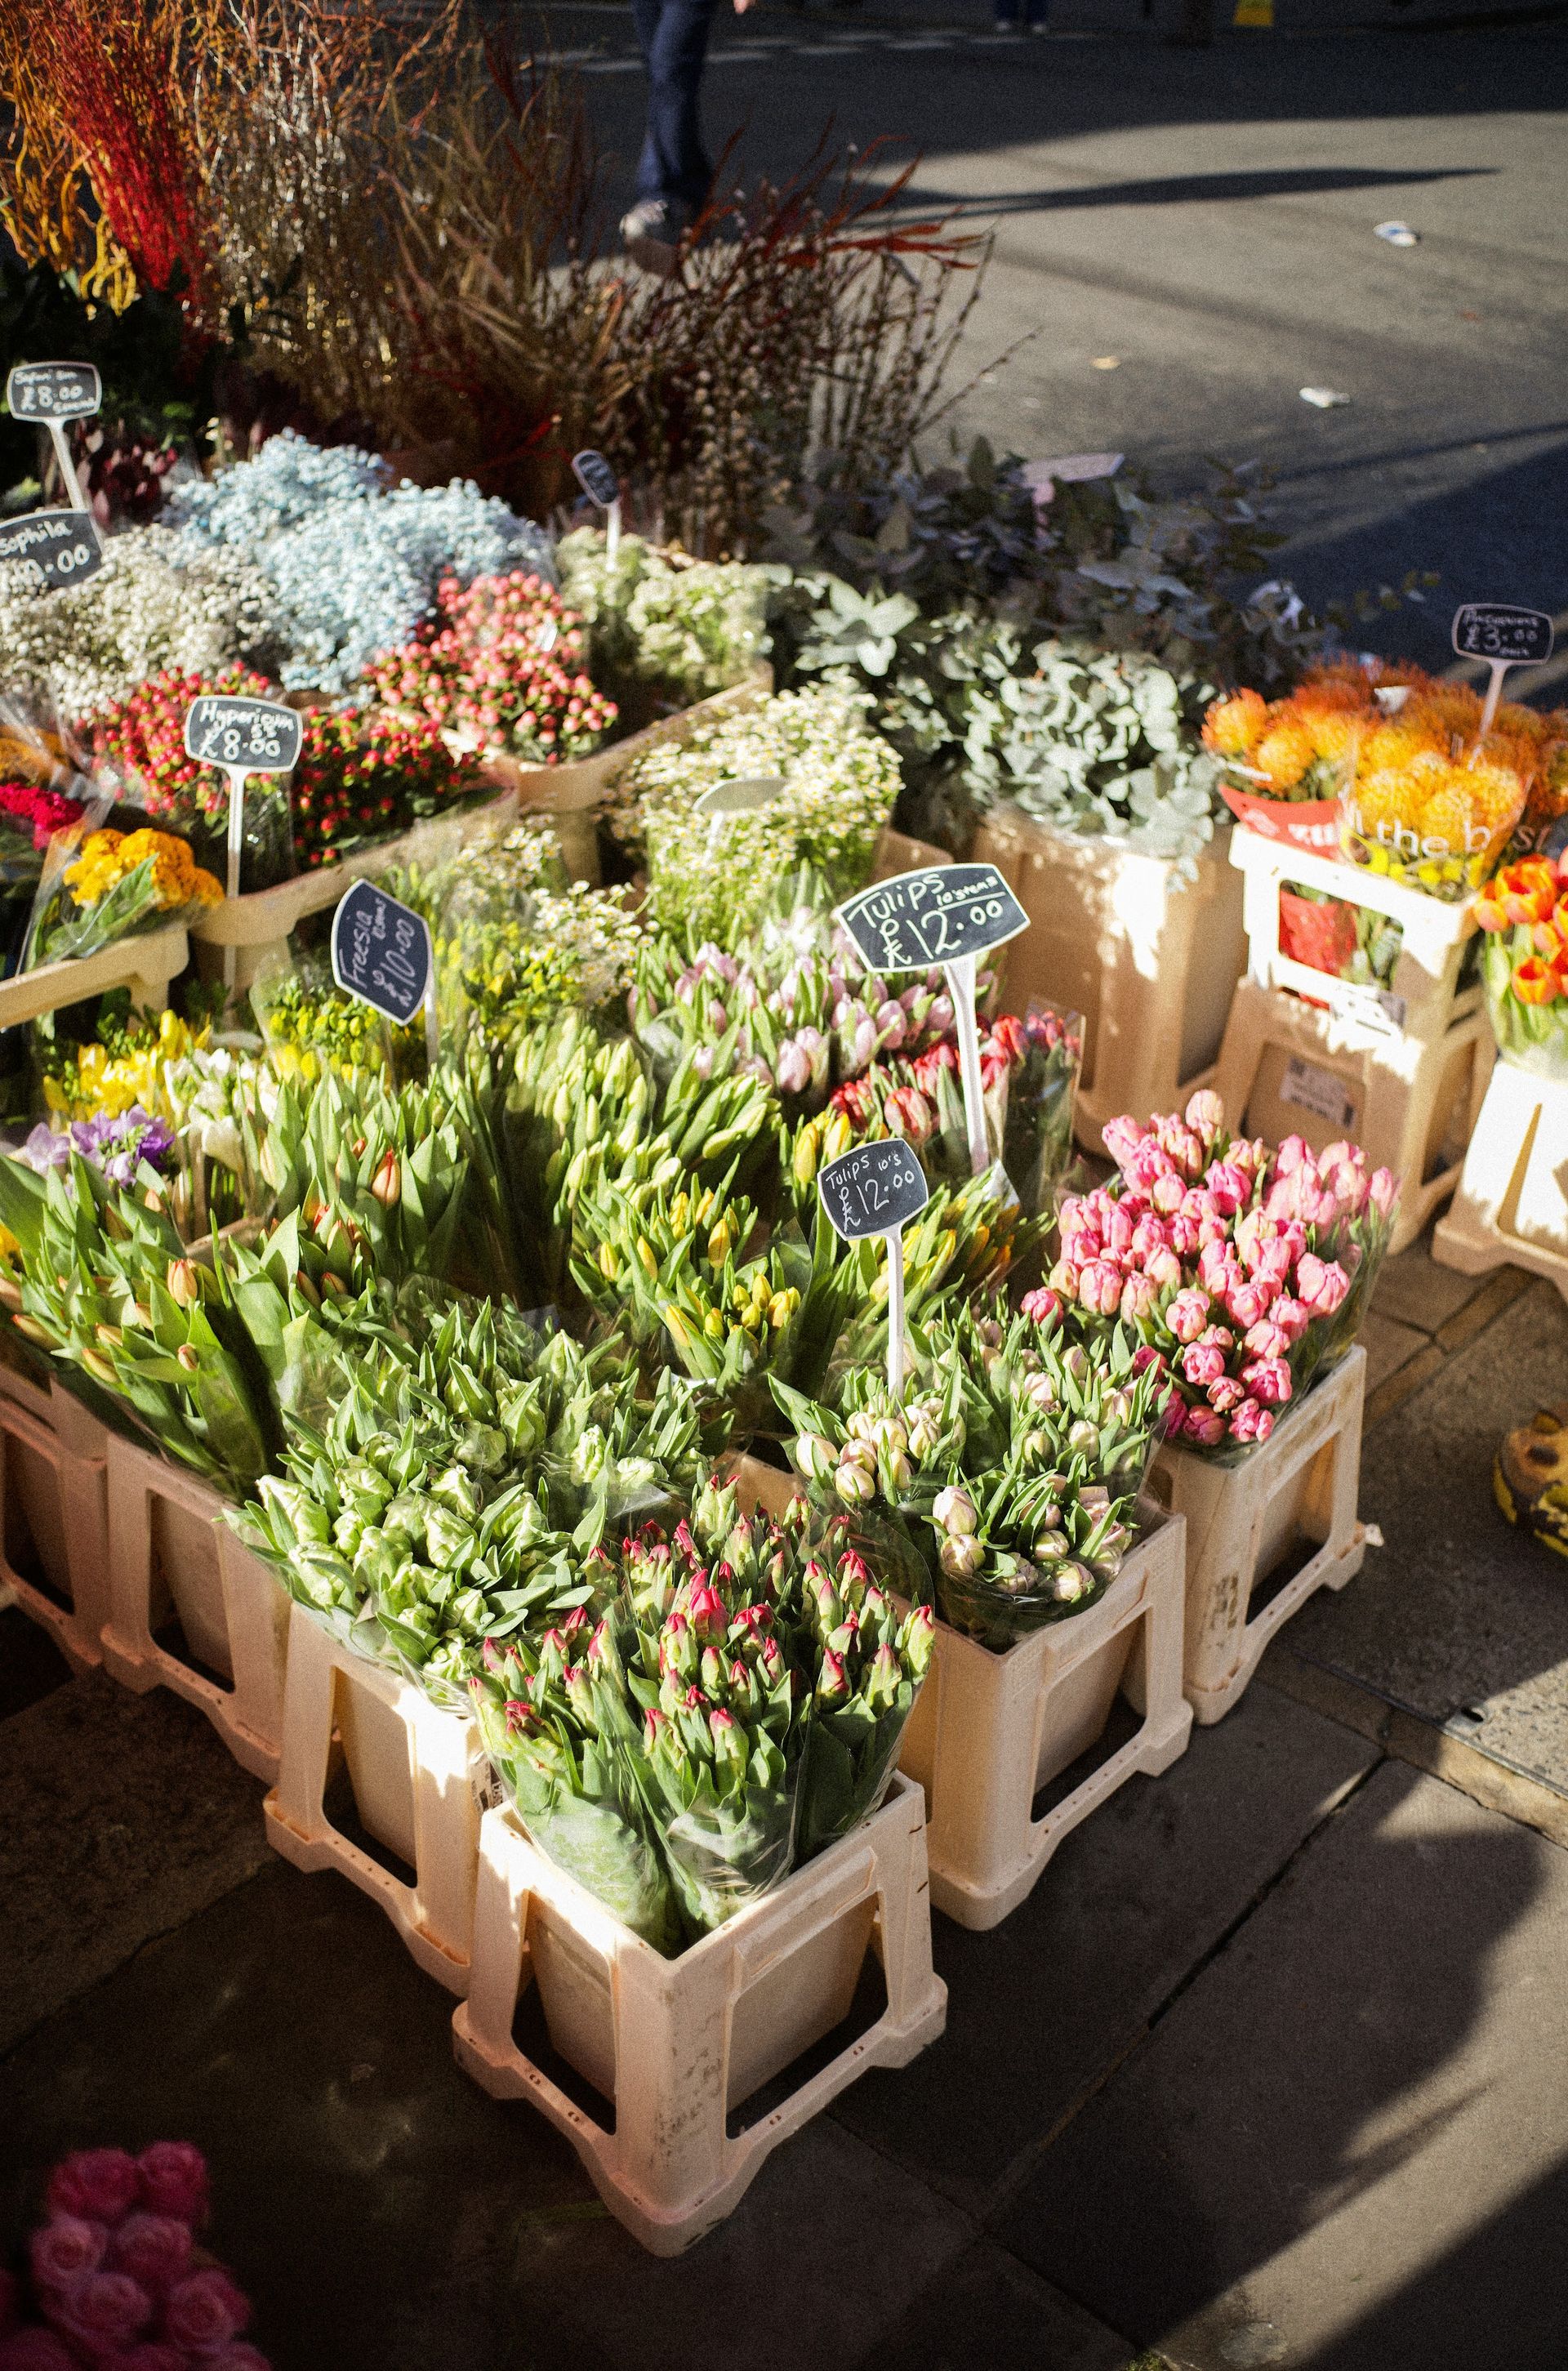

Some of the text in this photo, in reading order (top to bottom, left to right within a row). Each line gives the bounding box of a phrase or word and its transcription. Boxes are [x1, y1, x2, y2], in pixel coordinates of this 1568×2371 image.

[20, 385, 83, 412] £8.00
[198, 722, 282, 761] £8.00
[1377, 818, 1450, 859] the
[338, 910, 373, 990] Freesia
[879, 899, 1004, 969] £12.00
[372, 917, 416, 1008] £10.00
[825, 1153, 902, 1191] Tulips 10's
[838, 1169, 915, 1233] £12.00
